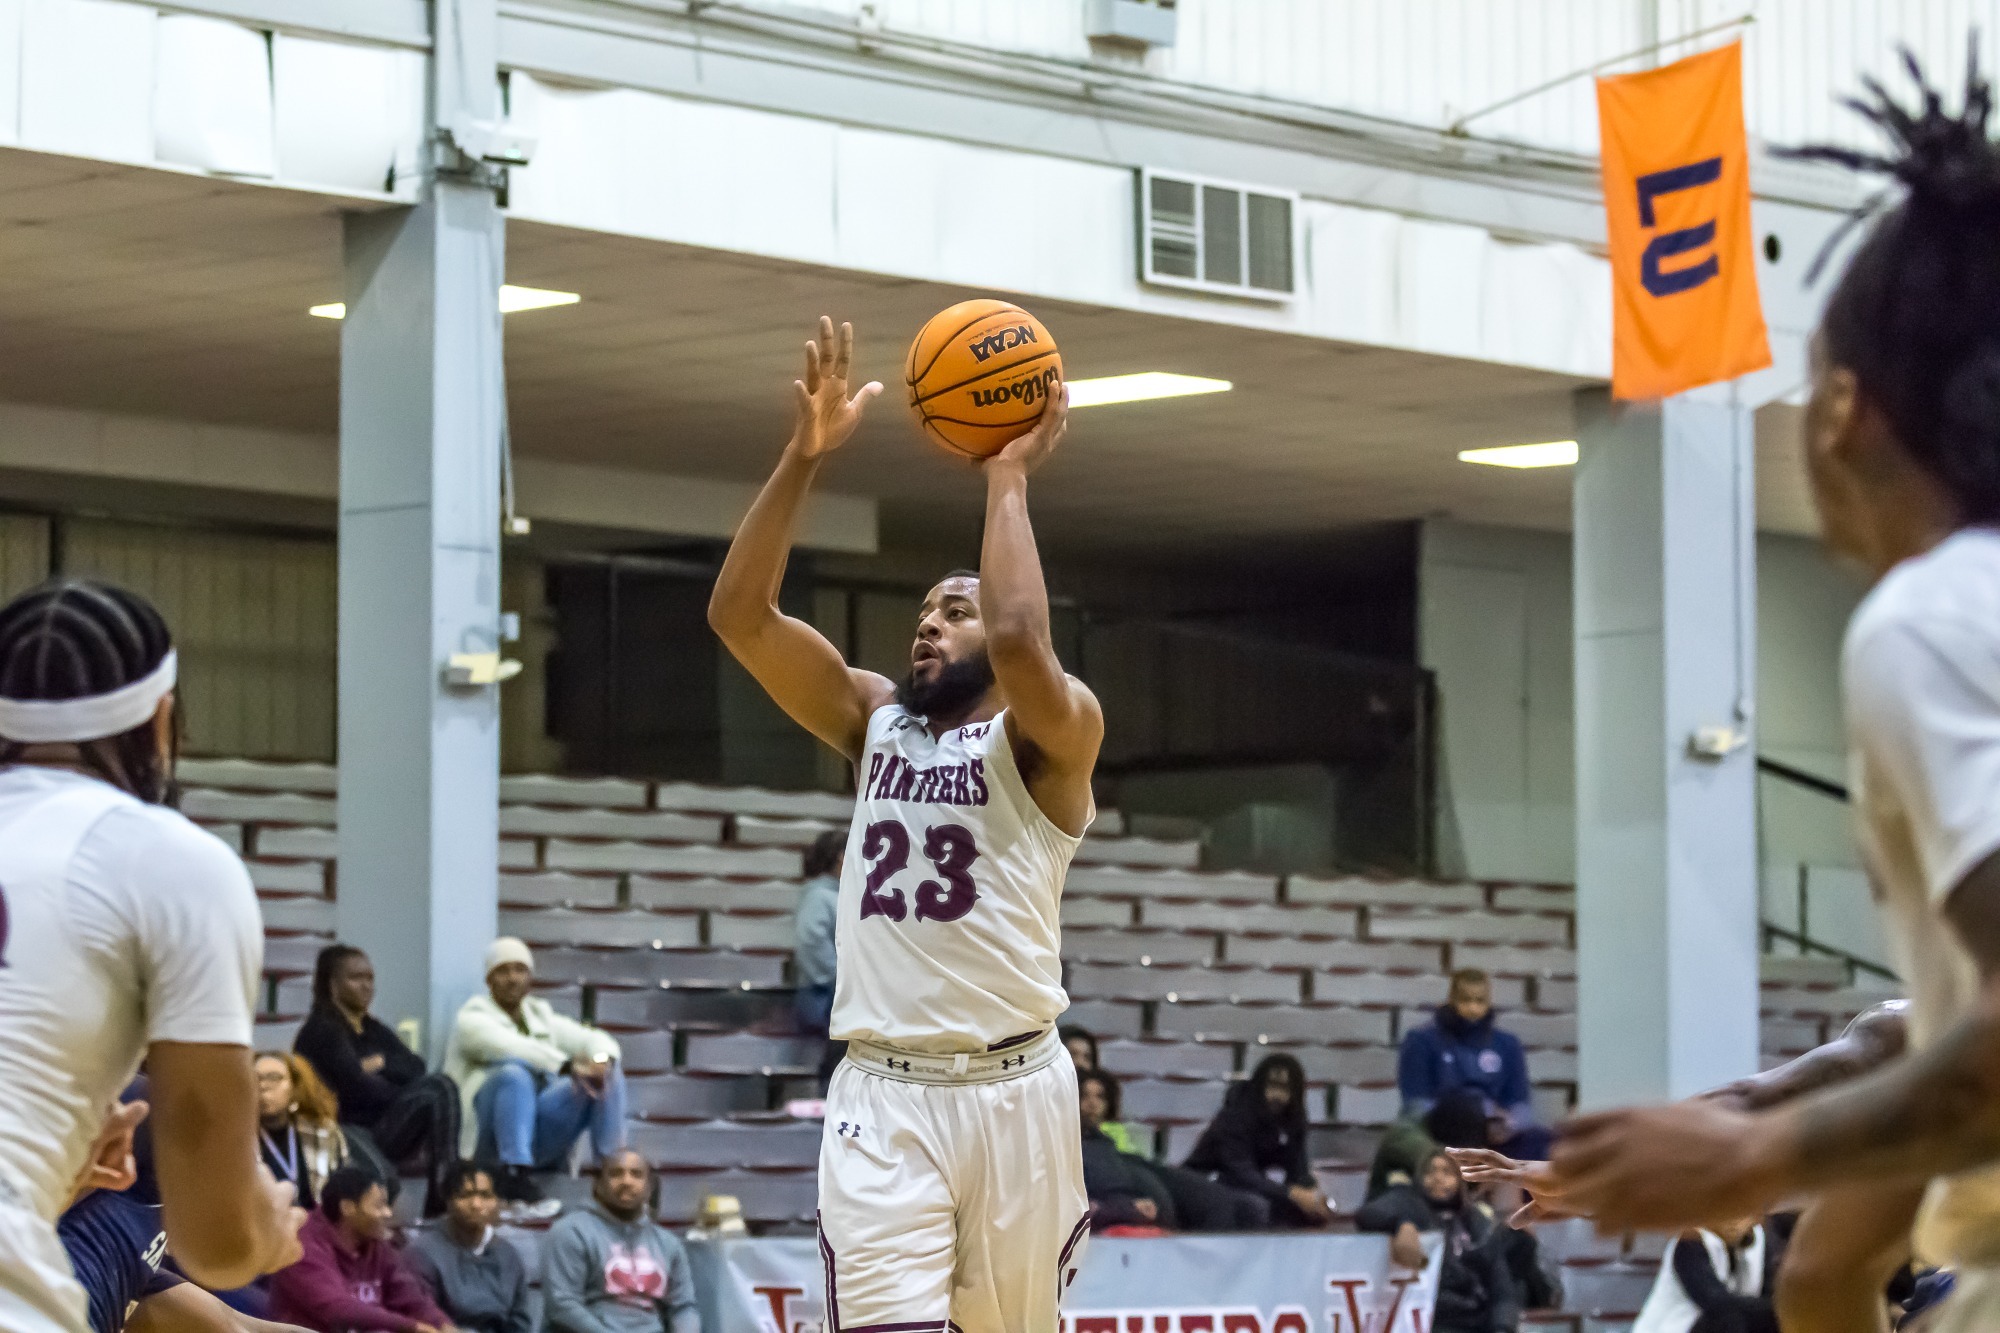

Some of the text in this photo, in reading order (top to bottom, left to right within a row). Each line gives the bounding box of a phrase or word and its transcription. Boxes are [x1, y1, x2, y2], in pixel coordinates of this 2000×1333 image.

[1636, 156, 1723, 298] LU
[968, 325, 1038, 363] NCAA
[972, 365, 1061, 408] Wilson
[860, 819, 982, 924] 23
